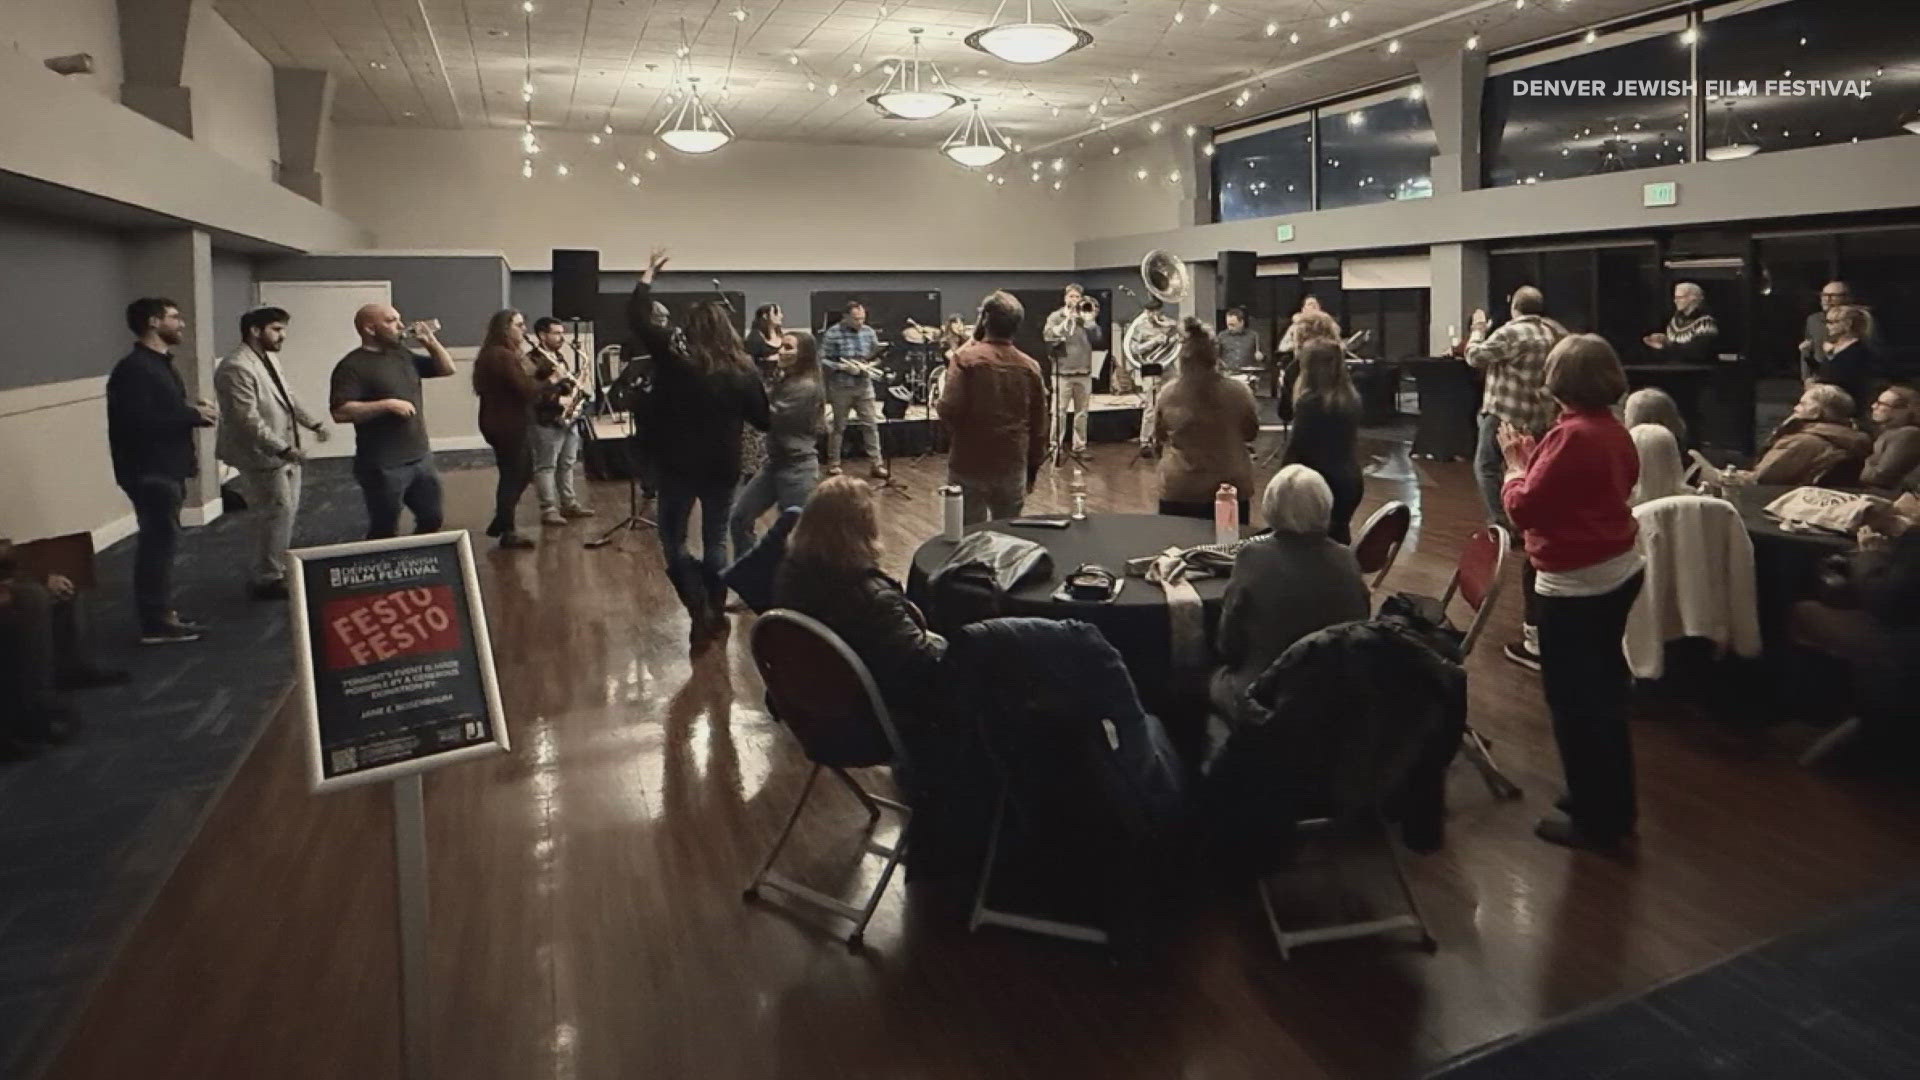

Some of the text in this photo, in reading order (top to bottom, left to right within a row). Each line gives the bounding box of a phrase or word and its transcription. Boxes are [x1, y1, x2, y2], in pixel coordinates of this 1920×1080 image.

[342, 561, 392, 576] DENVER
[343, 573, 376, 585] FILM
[379, 564, 441, 581] FESTIVAL
[350, 606, 449, 665] FESTO
